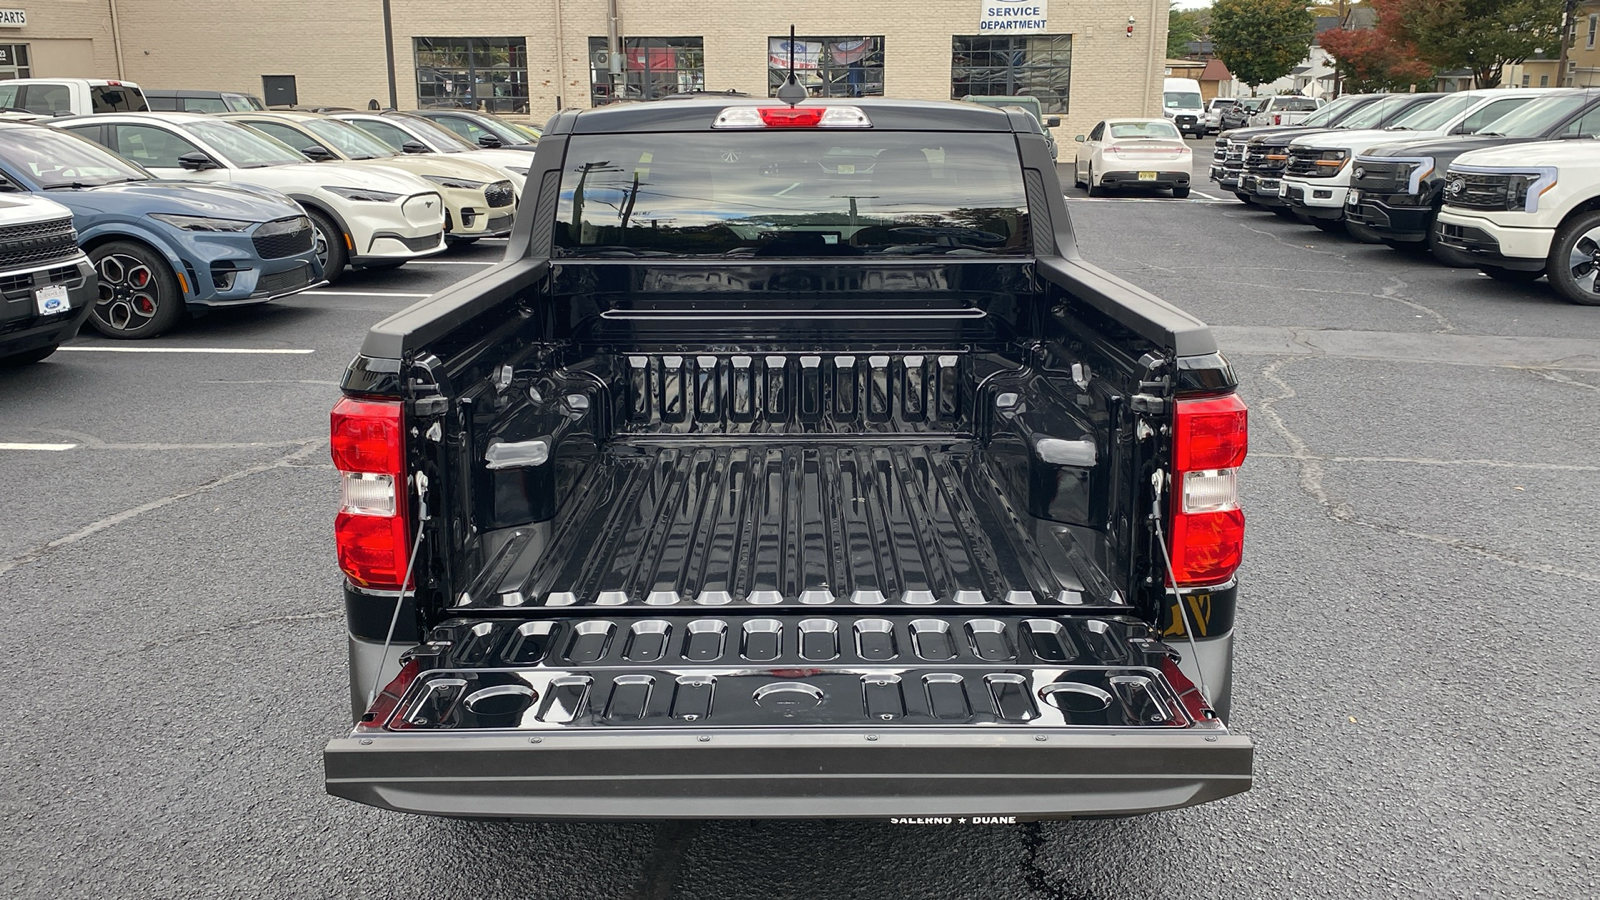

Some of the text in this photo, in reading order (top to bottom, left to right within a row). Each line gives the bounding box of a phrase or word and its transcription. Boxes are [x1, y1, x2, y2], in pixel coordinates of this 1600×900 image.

[988, 7, 1040, 16] SERVICE
[0, 11, 25, 23] PARTS
[980, 20, 1047, 29] DEPARTMENT
[0, 235, 70, 250] RONCO
[972, 816, 1016, 824] DUANE
